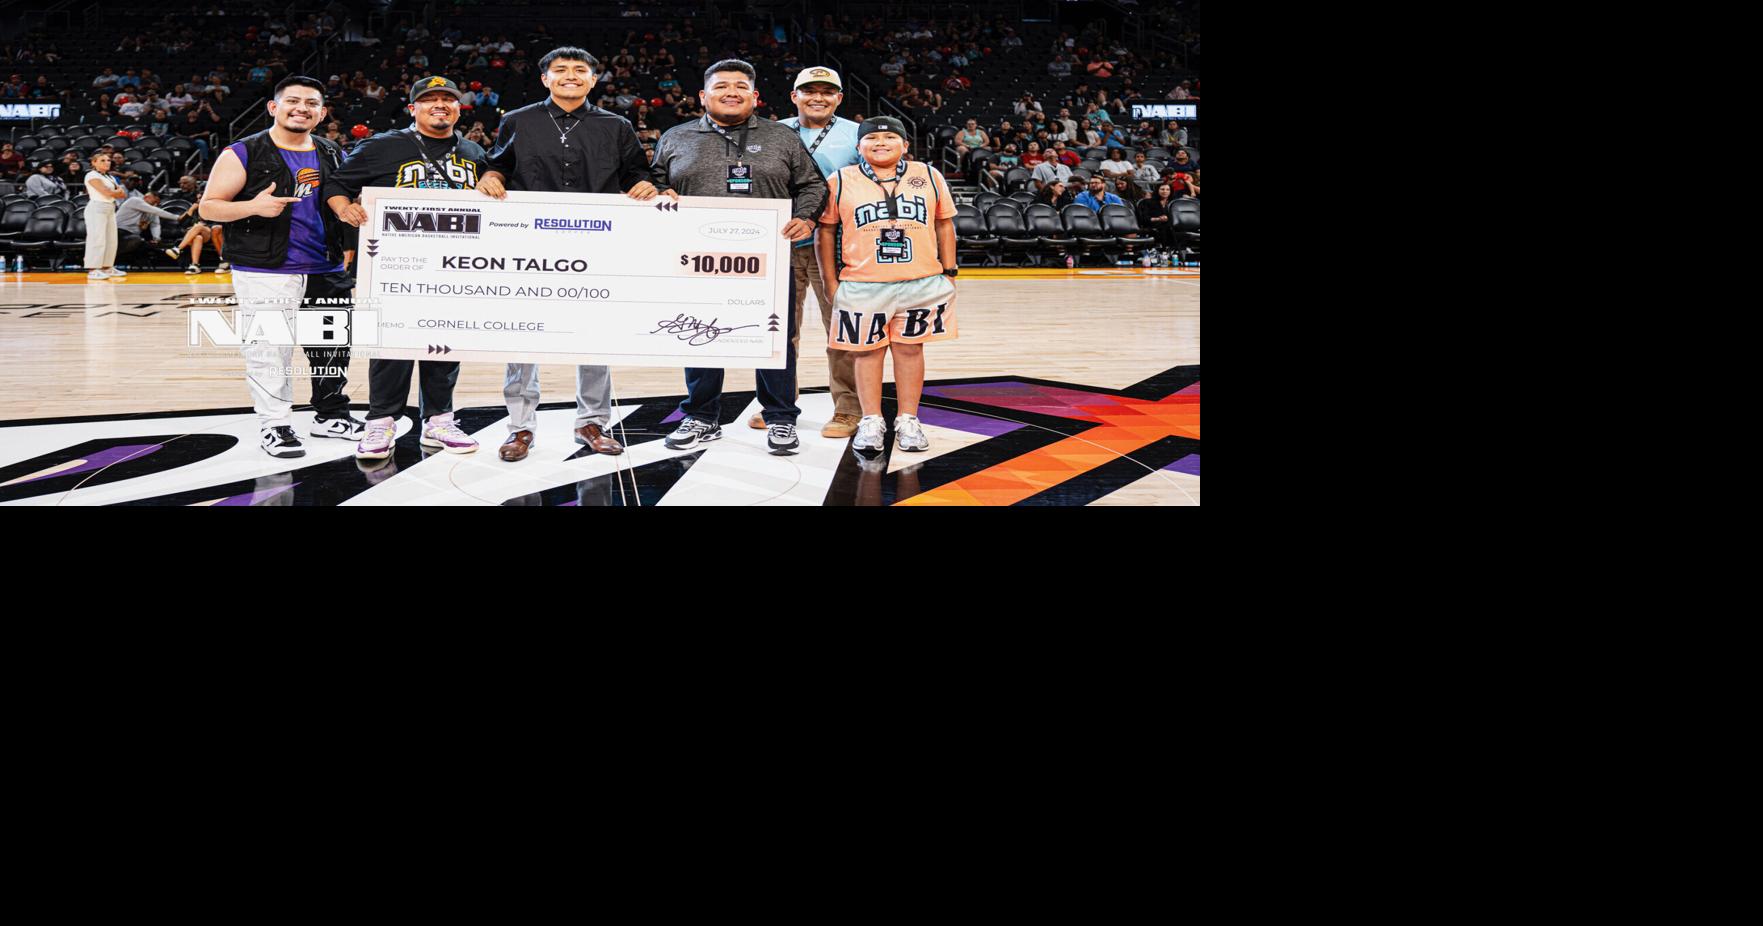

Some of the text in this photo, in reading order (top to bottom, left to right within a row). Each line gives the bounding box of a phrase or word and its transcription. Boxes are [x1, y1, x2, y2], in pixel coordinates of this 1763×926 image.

[1132, 104, 1197, 118] NABI
[382, 211, 481, 235] NABI
[489, 221, 529, 230] Powered by
[534, 218, 612, 232] RESOLUTION
[380, 263, 411, 271] ORDER
[442, 256, 588, 273] KEON TALGO
[380, 282, 610, 300] TEN THOUSAND AND 00/100
[417, 319, 480, 330] CORNELL
[483, 320, 545, 332] COLLEGE
